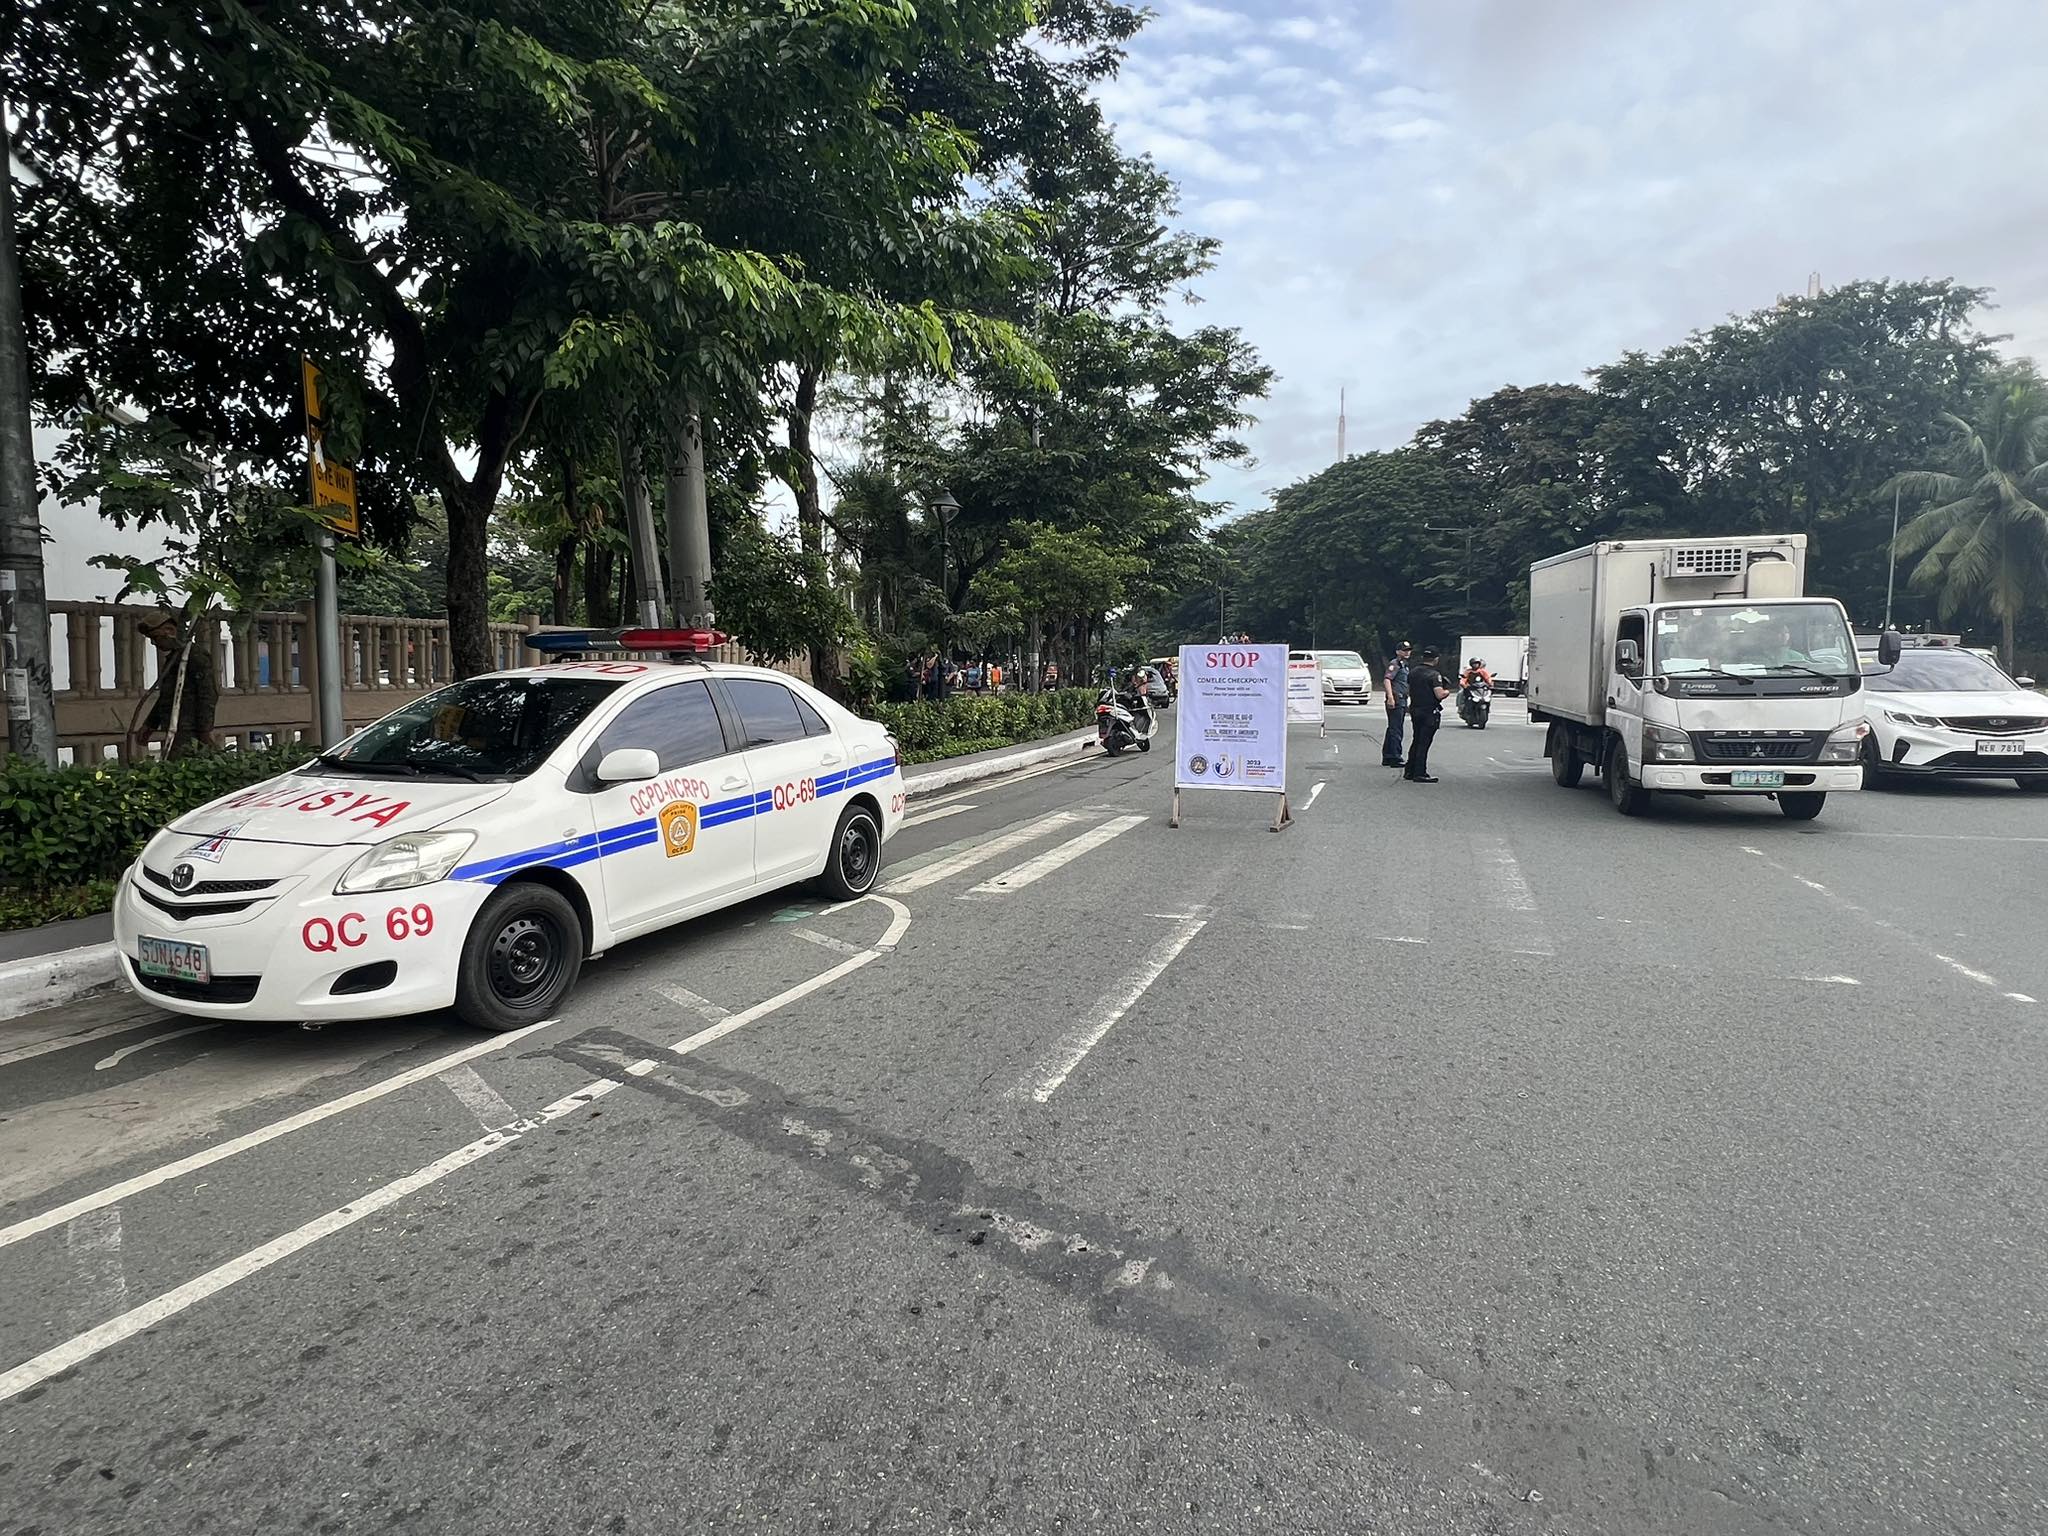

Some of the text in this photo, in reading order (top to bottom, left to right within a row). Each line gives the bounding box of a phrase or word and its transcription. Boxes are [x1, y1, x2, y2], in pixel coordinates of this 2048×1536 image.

[1206, 652, 1260, 669] STOP
[630, 778, 710, 816] QCPD-NCRPO
[774, 777, 815, 811] QC-69
[302, 903, 433, 952] QC 69
[174, 945, 202, 972] 648
